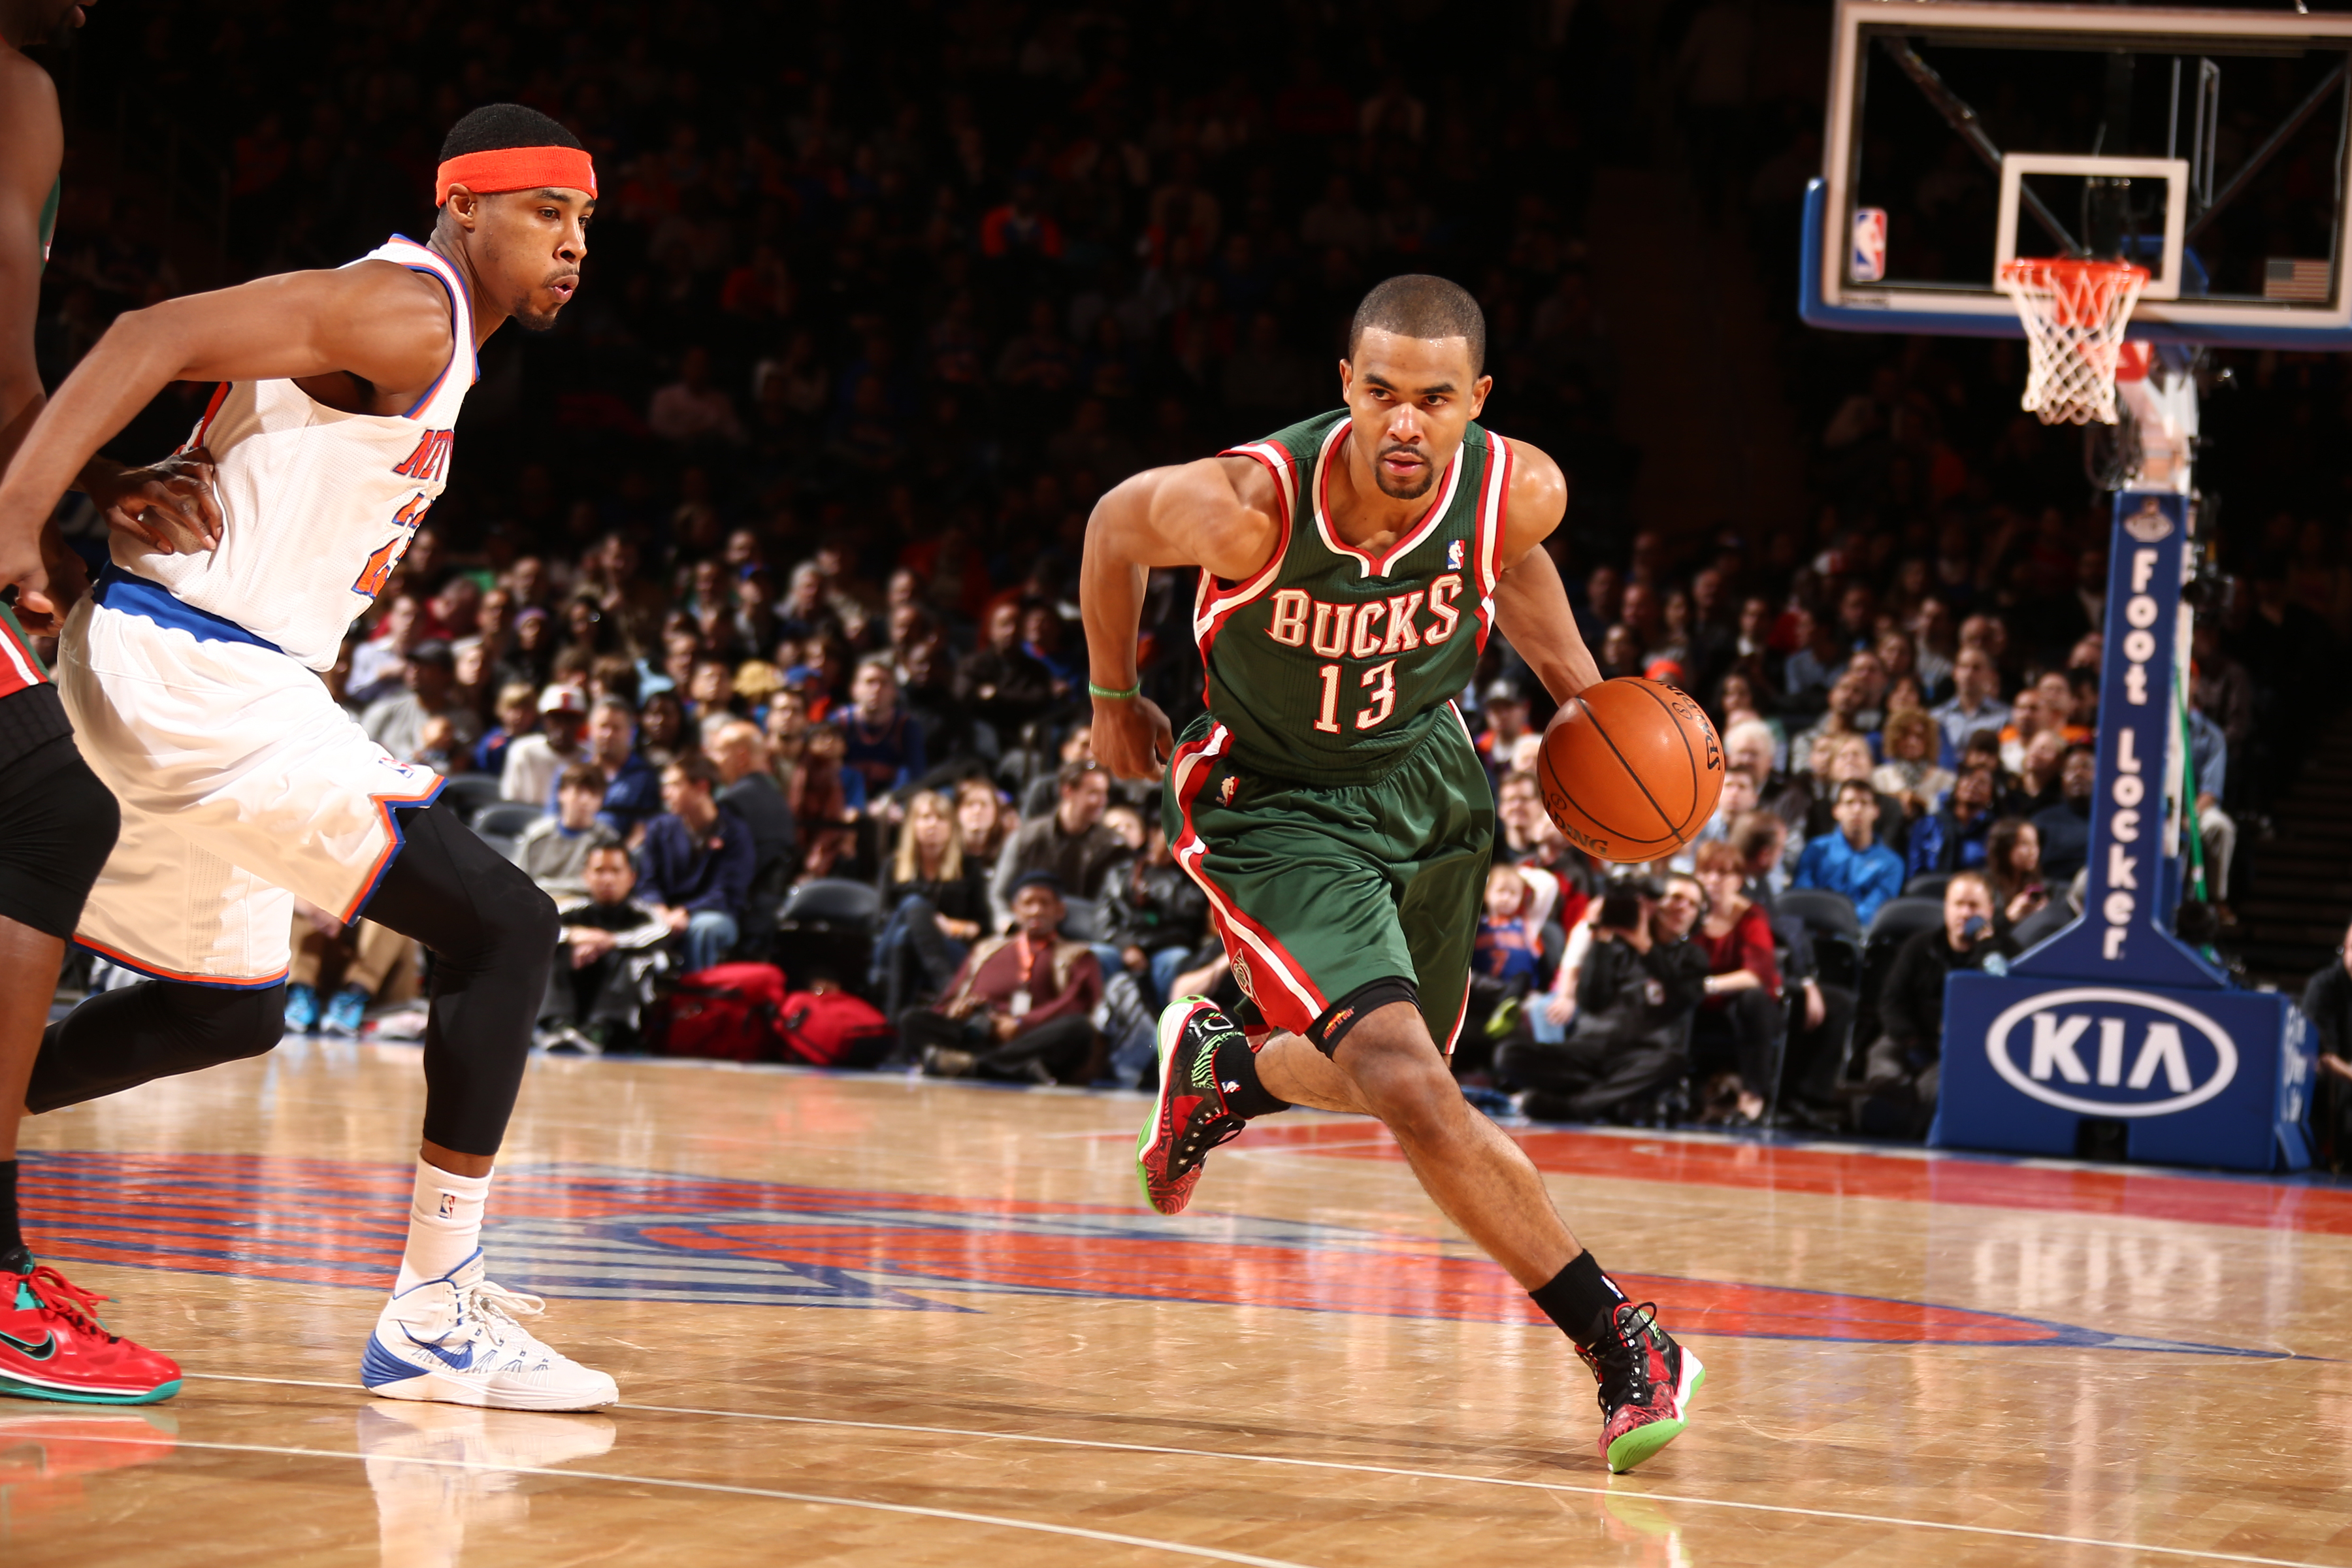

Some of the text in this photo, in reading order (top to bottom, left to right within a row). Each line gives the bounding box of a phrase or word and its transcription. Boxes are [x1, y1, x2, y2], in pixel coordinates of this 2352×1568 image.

[1264, 572, 1463, 659] BUCKS
[2123, 549, 2158, 706] Foot
[1314, 659, 1397, 734] 13
[2102, 727, 2145, 960] Locker
[2030, 1012, 2193, 1093] KIA
